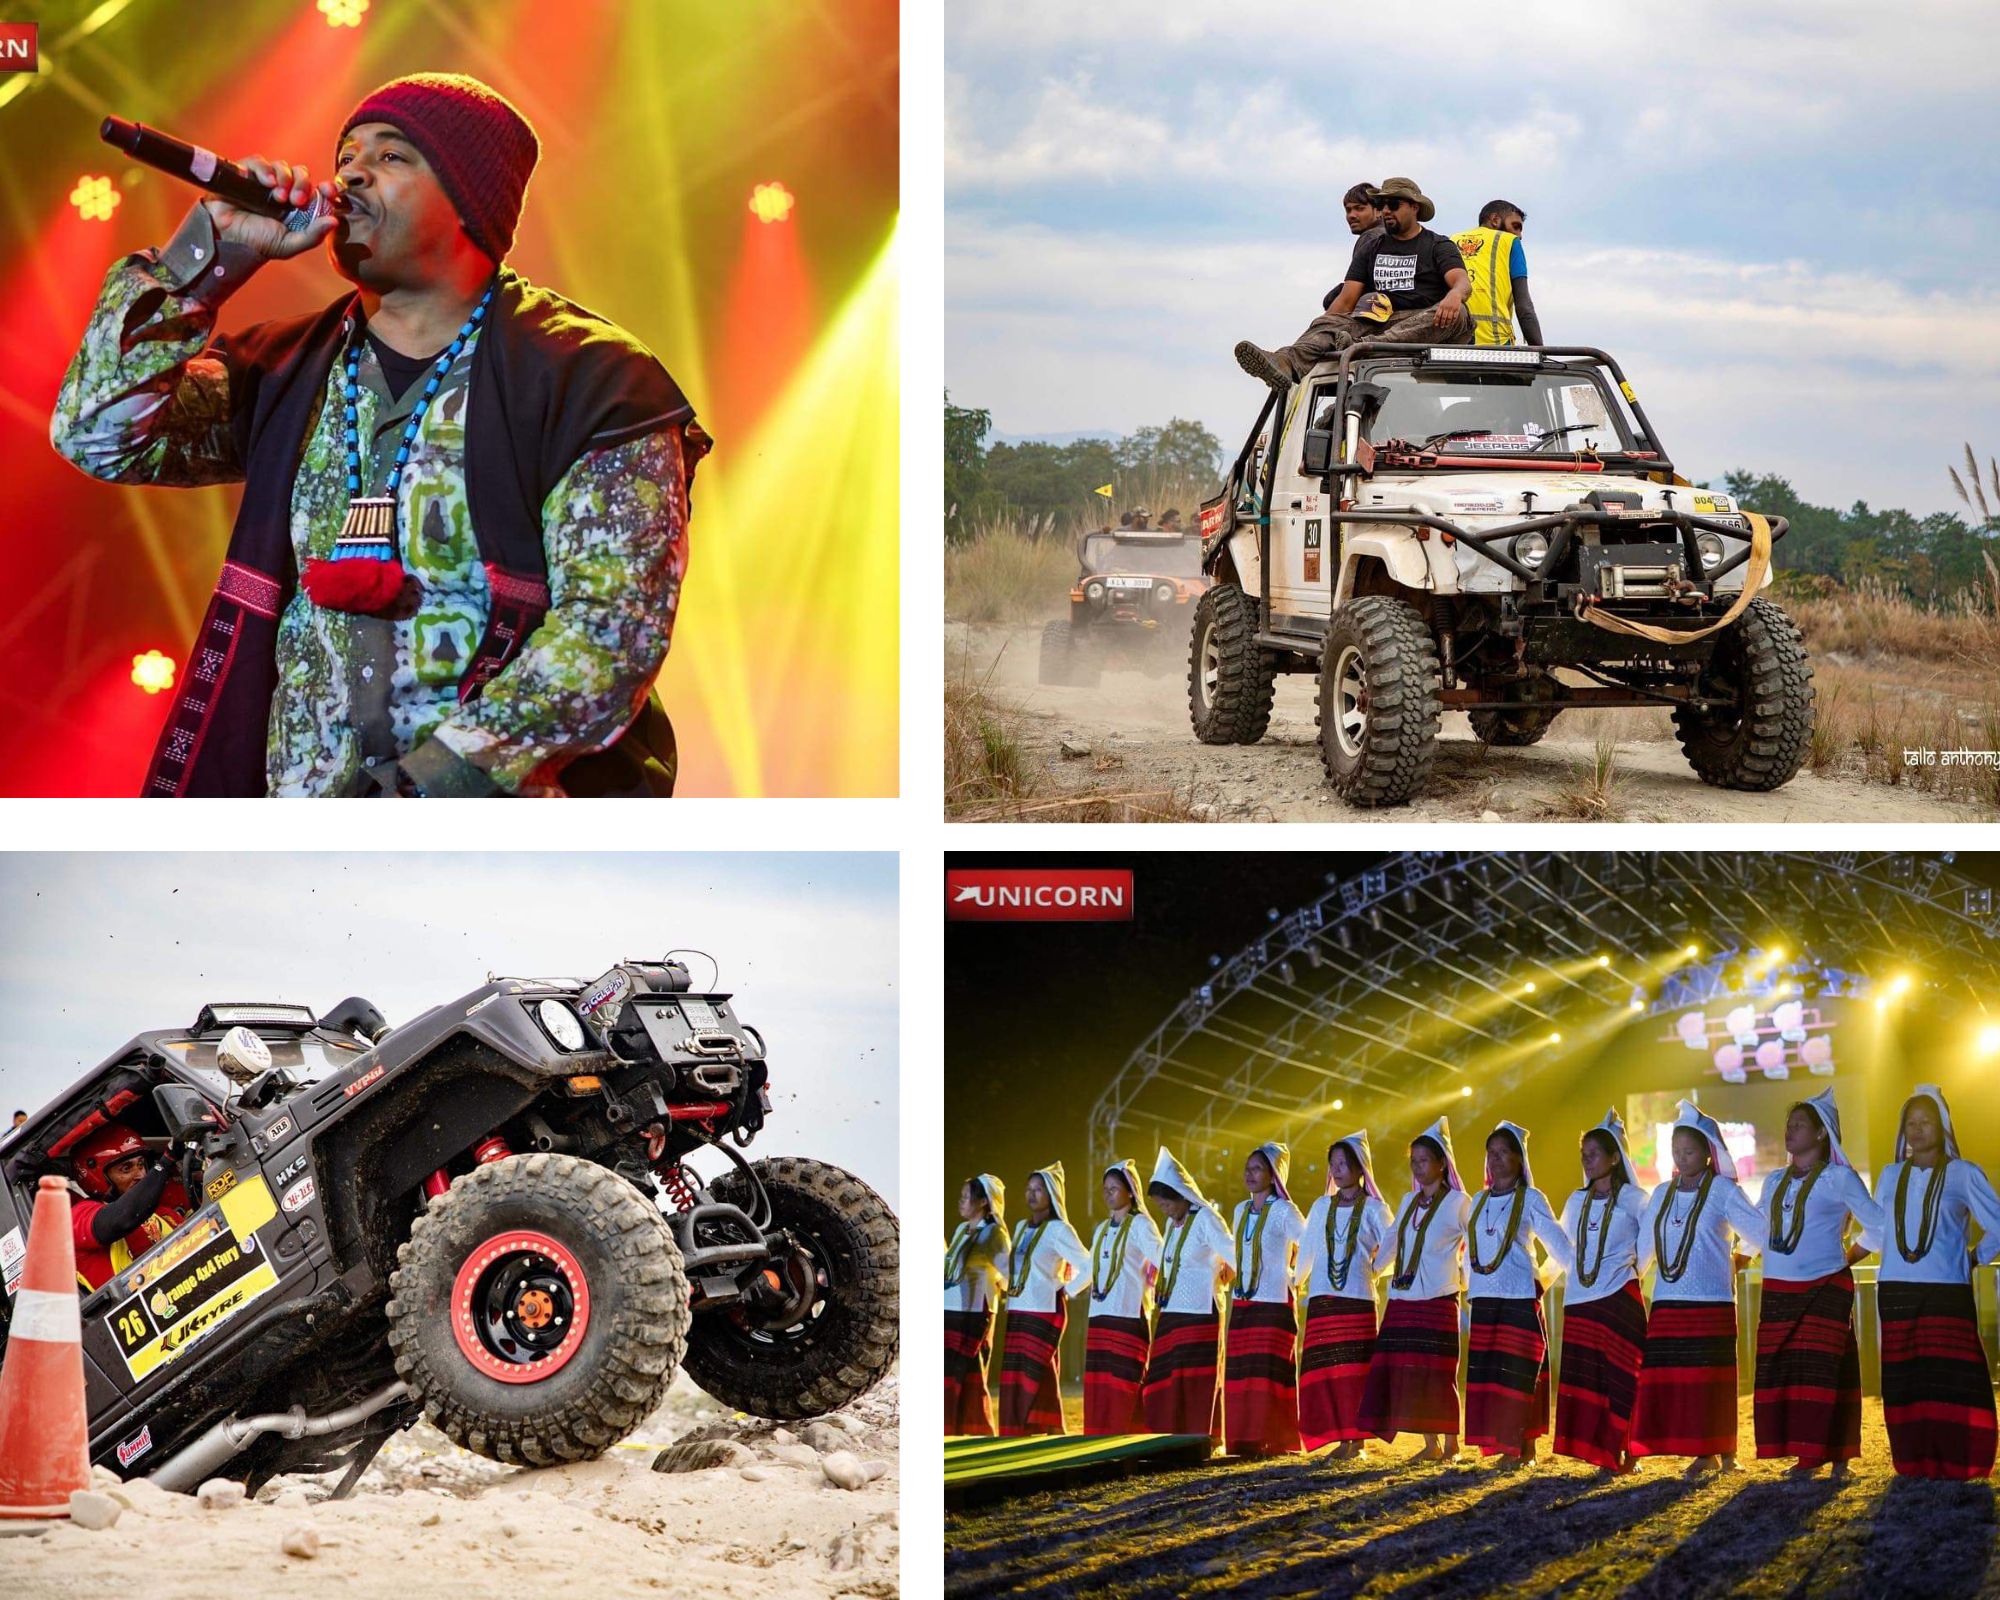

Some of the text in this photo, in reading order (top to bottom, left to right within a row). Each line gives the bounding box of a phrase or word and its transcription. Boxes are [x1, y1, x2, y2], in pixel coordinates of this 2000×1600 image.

[1375, 269, 1414, 278] RENEGADE
[1377, 257, 1415, 267] CAUTION
[1307, 523, 1318, 546] 30
[270, 1120, 289, 1139] ARB
[275, 1155, 308, 1186] HKS
[207, 1171, 233, 1196] RDP
[195, 1262, 217, 1284] 4x4
[213, 1245, 240, 1270] Fury
[118, 1309, 147, 1346] 26
